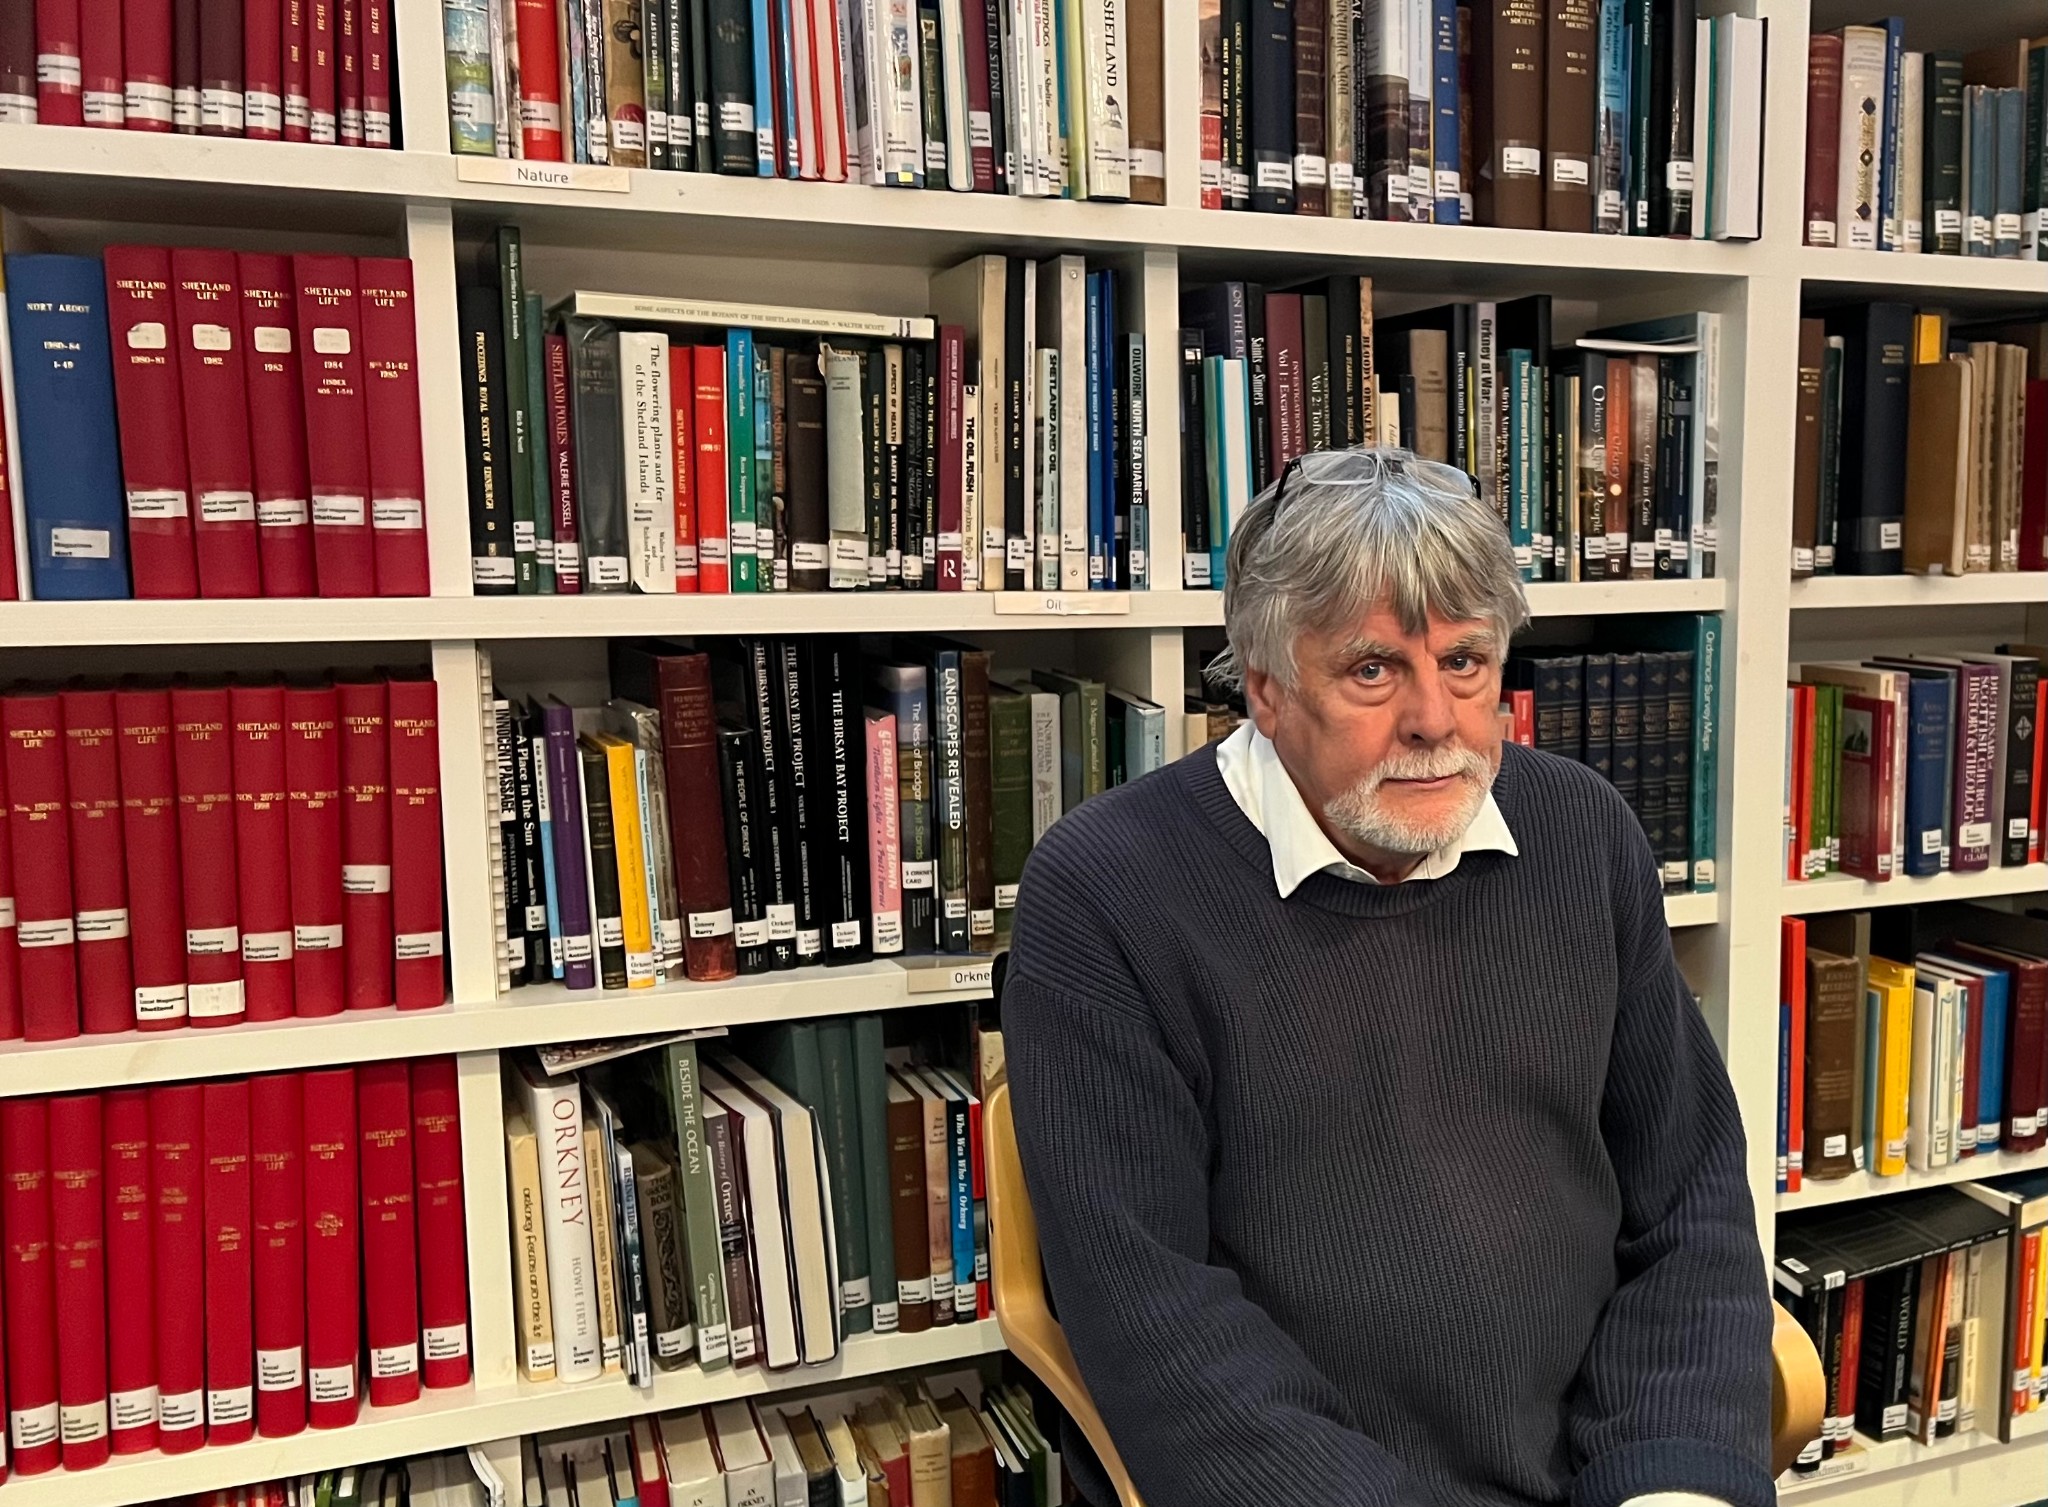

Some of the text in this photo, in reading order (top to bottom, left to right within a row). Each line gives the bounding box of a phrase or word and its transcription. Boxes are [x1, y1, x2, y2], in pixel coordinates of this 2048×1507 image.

[651, 13, 660, 82] ALASTAIR DAWSON
[985, 5, 1000, 98] SET IN STONE
[1102, 0, 1117, 87] SHETLAND
[1610, 23, 1621, 72] Prehistory
[517, 167, 570, 184] Nature
[116, 280, 166, 290] SHETLAND
[131, 290, 154, 299] LIFE
[181, 281, 231, 292] SHETLAND
[196, 291, 219, 300] LIFE
[244, 289, 291, 300] SHETLAND
[304, 286, 352, 297] SHETLAND
[318, 297, 340, 306] LIFE
[361, 288, 408, 299] SHETLAND
[375, 297, 396, 307] LIFE
[27, 303, 90, 313] NORT ABOOT
[258, 299, 280, 308] LIFE
[1232, 289, 1244, 336] ON THE
[324, 360, 343, 369] 1984
[475, 331, 487, 383] PROCEEDINGS
[1251, 337, 1265, 364] Saints
[1278, 348, 1289, 368] Vol
[1457, 351, 1466, 389] Between
[479, 386, 488, 412] ROYAL
[891, 398, 897, 409] OF
[1252, 373, 1267, 406] Sinners
[1292, 360, 1302, 446] INVESTIGATIONS IN
[1310, 374, 1323, 437] Vol 2: Tofts
[1457, 390, 1466, 414] tomb
[1480, 318, 1492, 467] Orkney at War: Defending
[481, 415, 490, 448] SOCIETY
[636, 364, 650, 494] of the Shetland Islands
[651, 344, 664, 483] The flowering plants and
[1048, 353, 1058, 475] SHETLAND AND OIL
[1132, 347, 1143, 504] OILWORK NORTH SEA DIARIES
[1279, 383, 1292, 450] Excavations
[1457, 415, 1466, 432] and
[551, 344, 571, 528] SHETLAND PONIES VALERIE RUSSELL
[483, 451, 491, 461] OF
[966, 416, 975, 493] THE OIL RUSH
[1611, 435, 1621, 480] Orkney
[891, 485, 897, 496] IN
[1046, 598, 1062, 611] Oil
[1705, 630, 1716, 683] Ordnance
[755, 645, 775, 773] THE BIRSAY BAY PROJECT
[785, 645, 805, 789] THE BIRSAY BAY PROJECT
[832, 689, 843, 716] THE
[911, 701, 922, 721] The
[1702, 684, 1715, 720] Survey
[1967, 676, 1980, 736] HISTORY
[10, 729, 56, 738] SHETLAND
[23, 739, 44, 748] LIFE
[236, 722, 281, 731] SHETLAND
[249, 731, 270, 740] LIFE
[291, 721, 335, 730] SHETLAND
[304, 731, 324, 739] LIFE
[833, 718, 845, 762] BIRSAY
[911, 723, 922, 747] Ness
[1702, 721, 1713, 752] Maps
[1966, 738, 1977, 749] &
[495, 707, 515, 814] INNOCENT PASSAGE
[911, 748, 922, 760] of
[944, 667, 961, 830] LANDSCAPES REVEALED
[1036, 720, 1045, 774] EARLDOMS
[1044, 720, 1054, 773] NORTHERN
[1974, 675, 1990, 819] SCOTTISH CHURCH
[516, 734, 535, 847] A Place in the Sun
[836, 763, 847, 788] BAY
[911, 760, 923, 801] Brodgar
[735, 760, 751, 859] THE PEOPLE OF ORKNEY
[837, 789, 850, 843] PROJECT
[878, 729, 898, 890] GEORGE MACKAY BROWN
[913, 803, 923, 816] As
[508, 832, 518, 878] JONATHAN
[914, 824, 923, 860] Stands
[510, 879, 519, 905] WILLS
[679, 1059, 700, 1174] BESIDE THE OCEAN
[552, 1099, 585, 1227] ORKNEY
[956, 1113, 967, 1230] Who Was Who in Orkney
[623, 1166, 638, 1235] RISING TIDES
[571, 1256, 587, 1337] HOWIE FIRTH
[1896, 1295, 1911, 1349] WORLD
